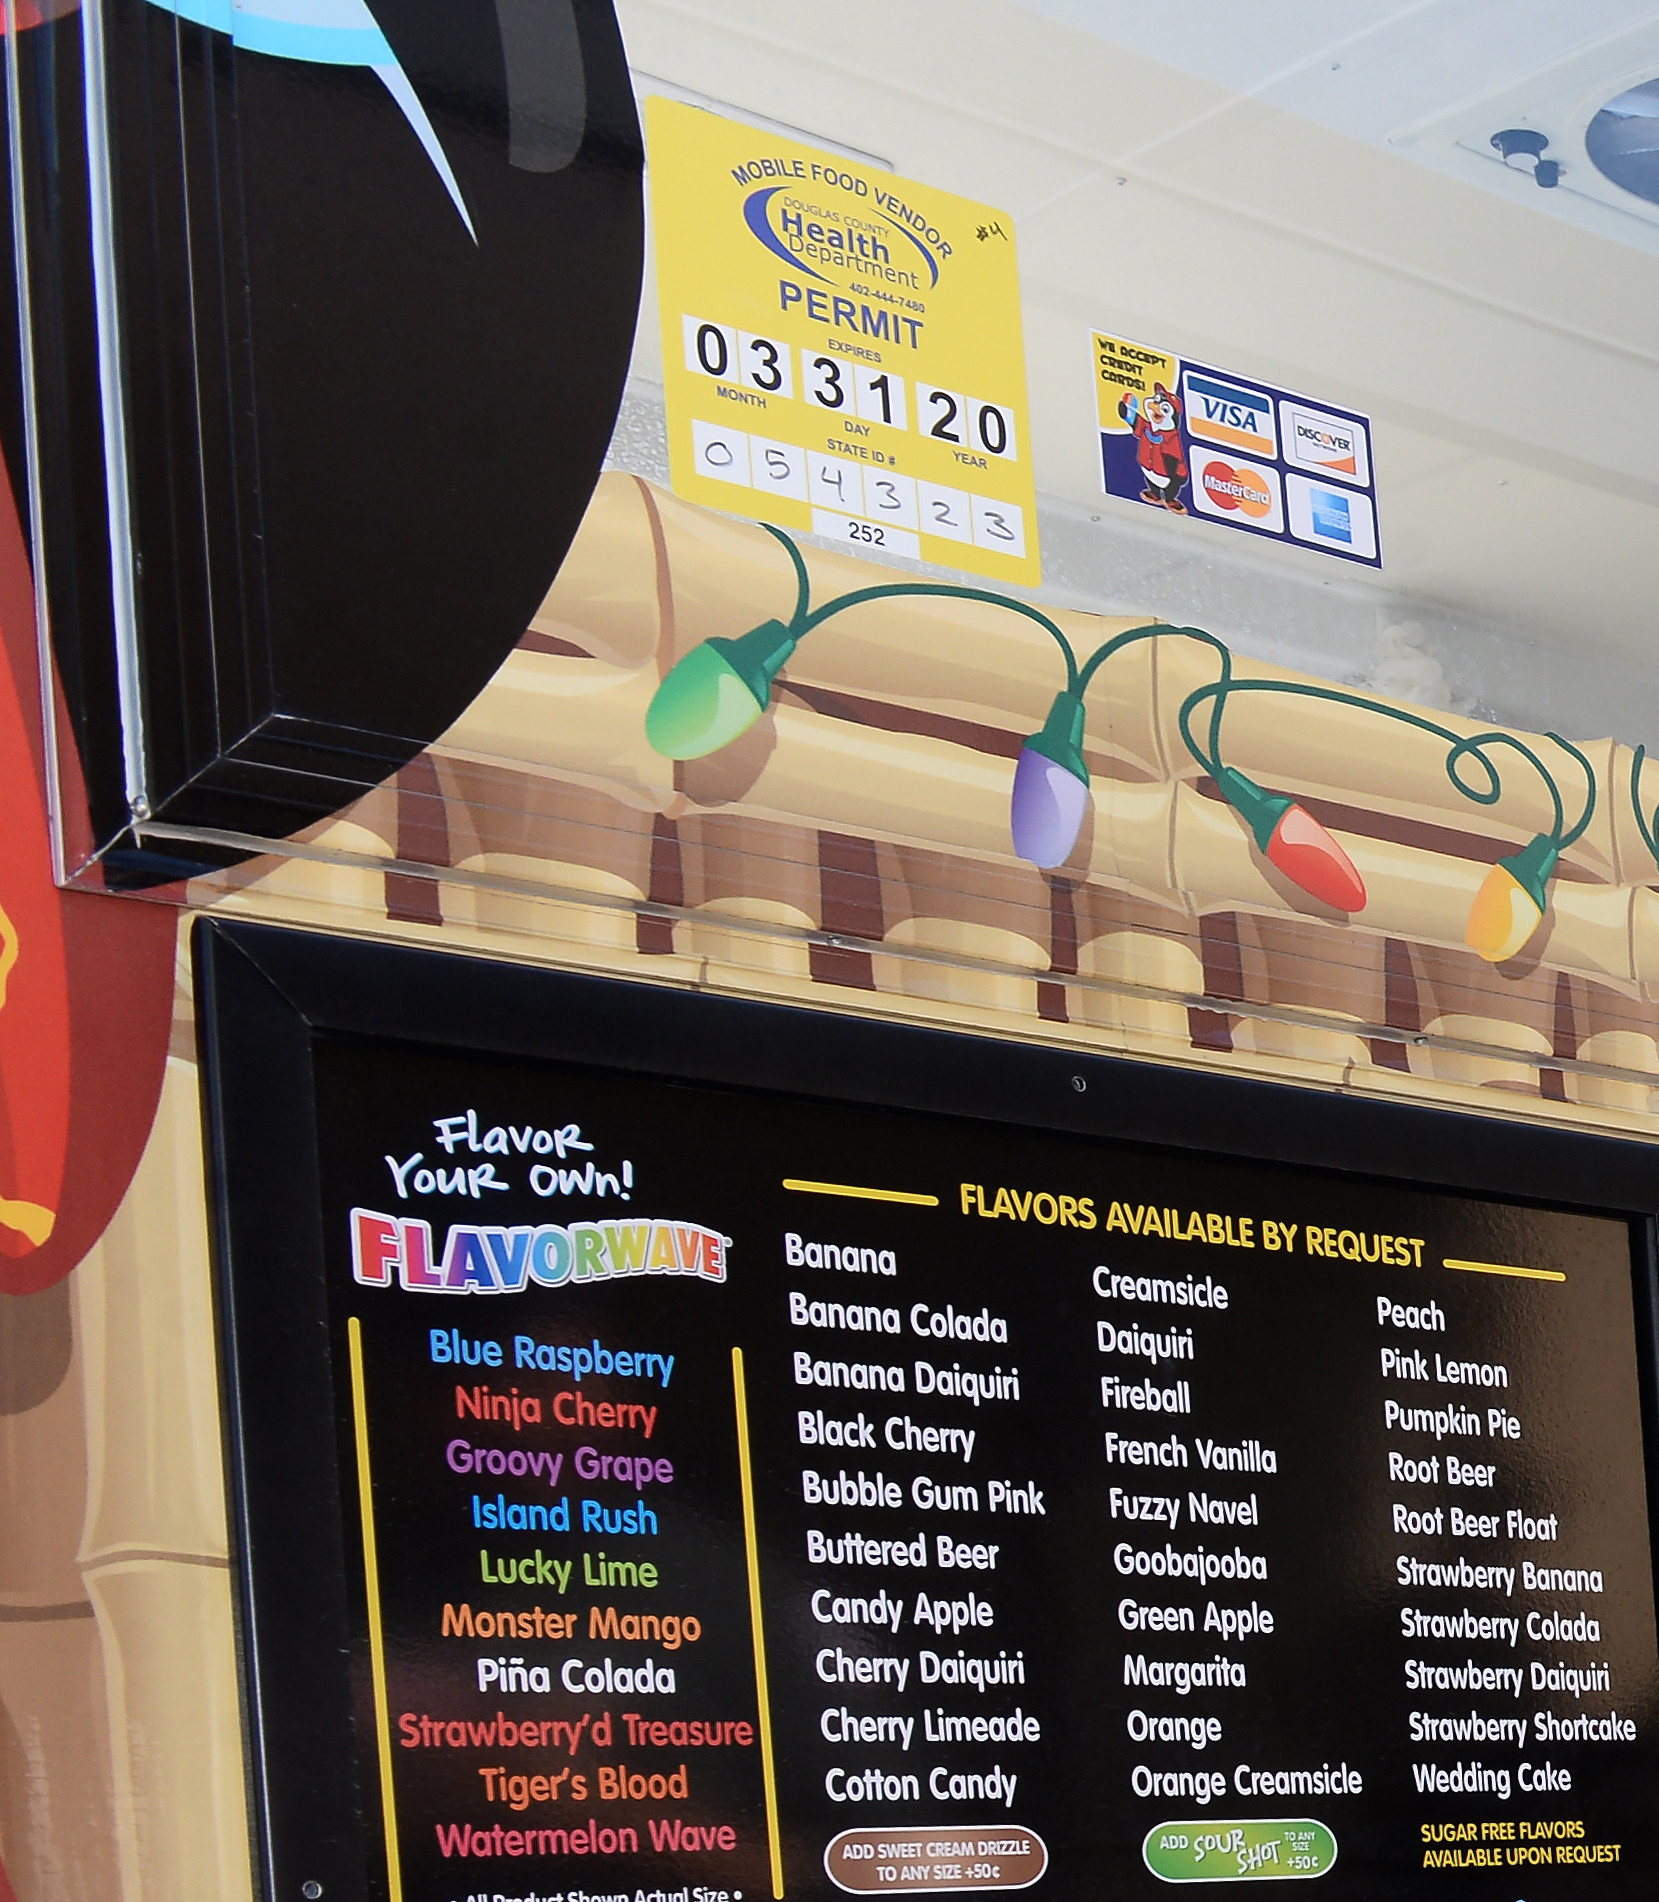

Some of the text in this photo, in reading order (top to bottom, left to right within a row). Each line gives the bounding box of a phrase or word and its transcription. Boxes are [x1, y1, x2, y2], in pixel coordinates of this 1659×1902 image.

[731, 159, 952, 259] MOBILE FOOD VENDOR
[783, 196, 889, 238] DOUGLAS COUNTY
[780, 208, 890, 264] Health
[976, 222, 1007, 241] #4
[789, 234, 919, 290] Department
[779, 279, 924, 349] PERMIT
[850, 282, 925, 313] 402-444-7480
[827, 337, 883, 364] EXPIRES
[1099, 338, 1167, 369] WE ACCEPT
[1100, 355, 1143, 376] CREDIT
[716, 383, 767, 411] MONTH
[1101, 369, 1146, 391] CARDS!
[843, 419, 871, 438] DAY
[1200, 396, 1259, 433] VISA
[826, 436, 897, 466] STATE ID #
[1297, 424, 1350, 451] DISCOVER
[951, 448, 988, 471] YEAR
[1204, 474, 1269, 506] MasterCard
[848, 520, 886, 546] 252
[961, 1184, 1424, 1267] FLAVORS AVAILABLE BY REQUEST
[351, 1208, 727, 1293] FLAVORWAVE
[785, 1233, 896, 1275] Banana
[1093, 1266, 1228, 1309] Creamsicle
[789, 1292, 1007, 1343] Banana Colada
[1377, 1297, 1445, 1331] Peach
[430, 1328, 674, 1387] Blue Raspberry
[1097, 1321, 1193, 1365] Daiquiri
[1381, 1348, 1507, 1387] Pink Lemon
[456, 1386, 656, 1438] Ninja Cherry
[1101, 1376, 1190, 1413] Fireball
[1385, 1400, 1520, 1440] Pumpkin Pie
[447, 1440, 673, 1490] Groovy Grape
[803, 1470, 1045, 1515] Bubble Gum Pink
[472, 1494, 657, 1535] Island Rush
[481, 1549, 657, 1594] Lucky Lime
[1114, 1543, 1267, 1585] Goobajooba
[442, 1603, 701, 1650] Monster Mango
[477, 1657, 675, 1693] Piña Colada
[1124, 1654, 1245, 1694] Margarita
[398, 1712, 753, 1755] Strawberry'd Treasure
[1410, 1711, 1636, 1748] Strawberry Shortcake
[479, 1765, 688, 1810] Tiger's Blood
[826, 1765, 1017, 1807] Cotton Candy
[1413, 1761, 1571, 1799] Wedding Cake
[436, 1819, 736, 1857] Watermelon Wave
